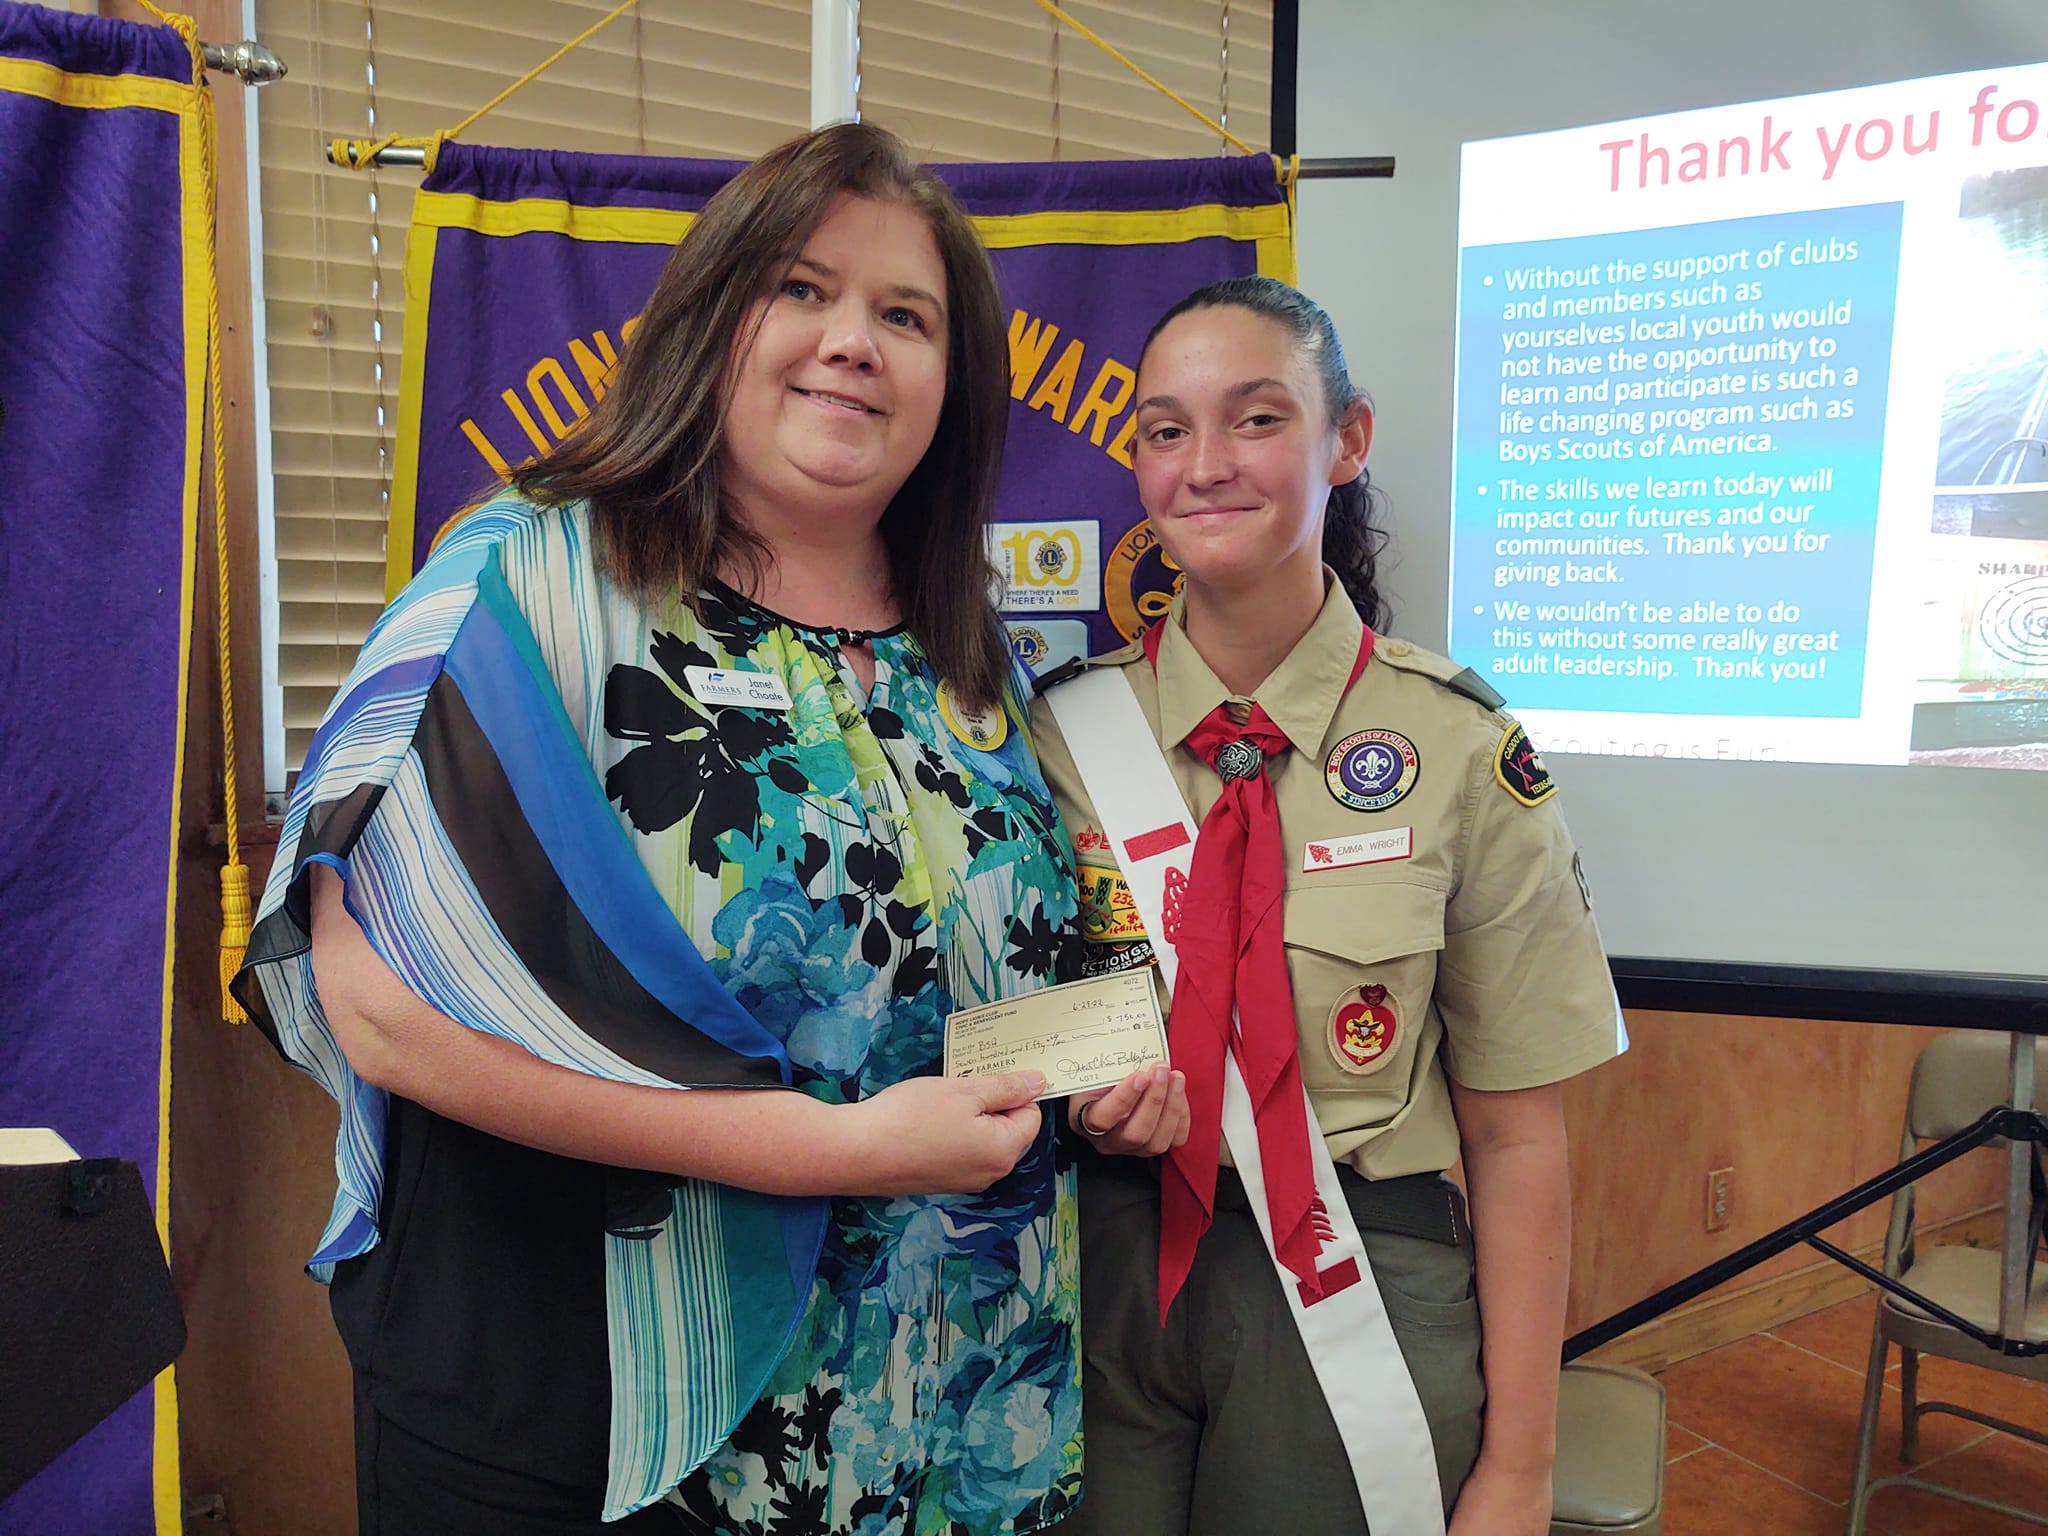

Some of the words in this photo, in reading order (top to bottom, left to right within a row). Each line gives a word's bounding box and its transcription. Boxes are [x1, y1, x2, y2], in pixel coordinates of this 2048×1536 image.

[1600, 116, 1792, 192] Thank
[1816, 110, 1940, 180] you
[1969, 85, 2048, 146] fo
[1504, 265, 1601, 292] Without
[1606, 258, 1647, 284] the
[1652, 248, 1750, 282] support
[1756, 240, 1785, 269] of
[1790, 236, 1858, 266] clubs
[1503, 295, 1547, 320] and
[1552, 289, 1666, 317] members
[1670, 279, 1727, 308] such
[1735, 281, 1762, 302] as
[1502, 321, 1625, 354] yourselves
[1630, 317, 1686, 342] local
[1692, 307, 1764, 342] youth
[1770, 299, 1851, 330] would
[1501, 355, 1541, 378] not
[1546, 352, 1602, 376] have
[1608, 348, 1648, 373] the
[1653, 337, 1803, 374] opportunity
[1808, 336, 1837, 358] to
[460, 316, 646, 484] LION
[1500, 382, 1559, 406] learn
[1564, 378, 1610, 404] and
[1614, 373, 1747, 406] participate
[1751, 368, 1771, 393] is
[1776, 362, 1836, 391] such
[1842, 366, 1859, 387] a
[1500, 410, 1535, 434] life
[1539, 408, 1646, 436] changing
[1650, 404, 1754, 434] program
[1760, 395, 1818, 423] such
[1825, 399, 1855, 419] as
[1500, 440, 1551, 466] Boys
[1557, 438, 1635, 461] Scouts
[1639, 433, 1667, 458] of
[1669, 430, 1780, 457] America.
[1497, 479, 1540, 501] The
[1544, 477, 1600, 501] skills
[1605, 481, 1641, 500] we
[1646, 476, 1707, 500] learn
[1713, 471, 1785, 499] today
[1789, 467, 1834, 494] will
[1496, 508, 1575, 534] impact
[1579, 511, 1620, 528] our
[1626, 505, 1712, 527] futures
[1716, 500, 1765, 525] and
[1769, 504, 1815, 525] our
[1000, 529, 1082, 588] 100
[1495, 533, 1651, 556] communities.
[1662, 531, 1736, 555] Thank
[1741, 535, 1788, 559] you
[1793, 528, 1831, 552] for
[1494, 561, 1562, 588] giving
[1564, 560, 1625, 583] back.
[1006, 596, 1043, 605] THERE'S
[1047, 596, 1055, 605] A
[1493, 600, 1532, 622] We
[1536, 600, 1639, 623] wouldn’t
[1642, 600, 1674, 624] be
[1678, 600, 1731, 624] able
[1735, 602, 1763, 624] to
[1767, 600, 1801, 624] do
[1492, 627, 1533, 649] this
[1538, 627, 1628, 650] without
[1631, 632, 1697, 651] some
[1702, 628, 1769, 656] really
[1772, 630, 1841, 656] great
[748, 677, 774, 689] Janet
[1491, 652, 1550, 674] adult
[1553, 652, 1680, 682] leadership.
[1691, 655, 1765, 678] Thank
[1770, 656, 1827, 684] you!
[701, 684, 742, 695] FARMERS
[1330, 746, 1345, 767] BOY
[1341, 731, 1373, 753] SCOUTS
[1382, 732, 1413, 760] AMERICA
[1347, 794, 1376, 807] SINCE
[1376, 792, 1396, 805] 1910
[1336, 844, 1364, 856] EMMA
[1369, 837, 1406, 851] WRIGHT
[1004, 1010, 1018, 1018] FUND
[976, 1057, 1016, 1074] FARMERS
